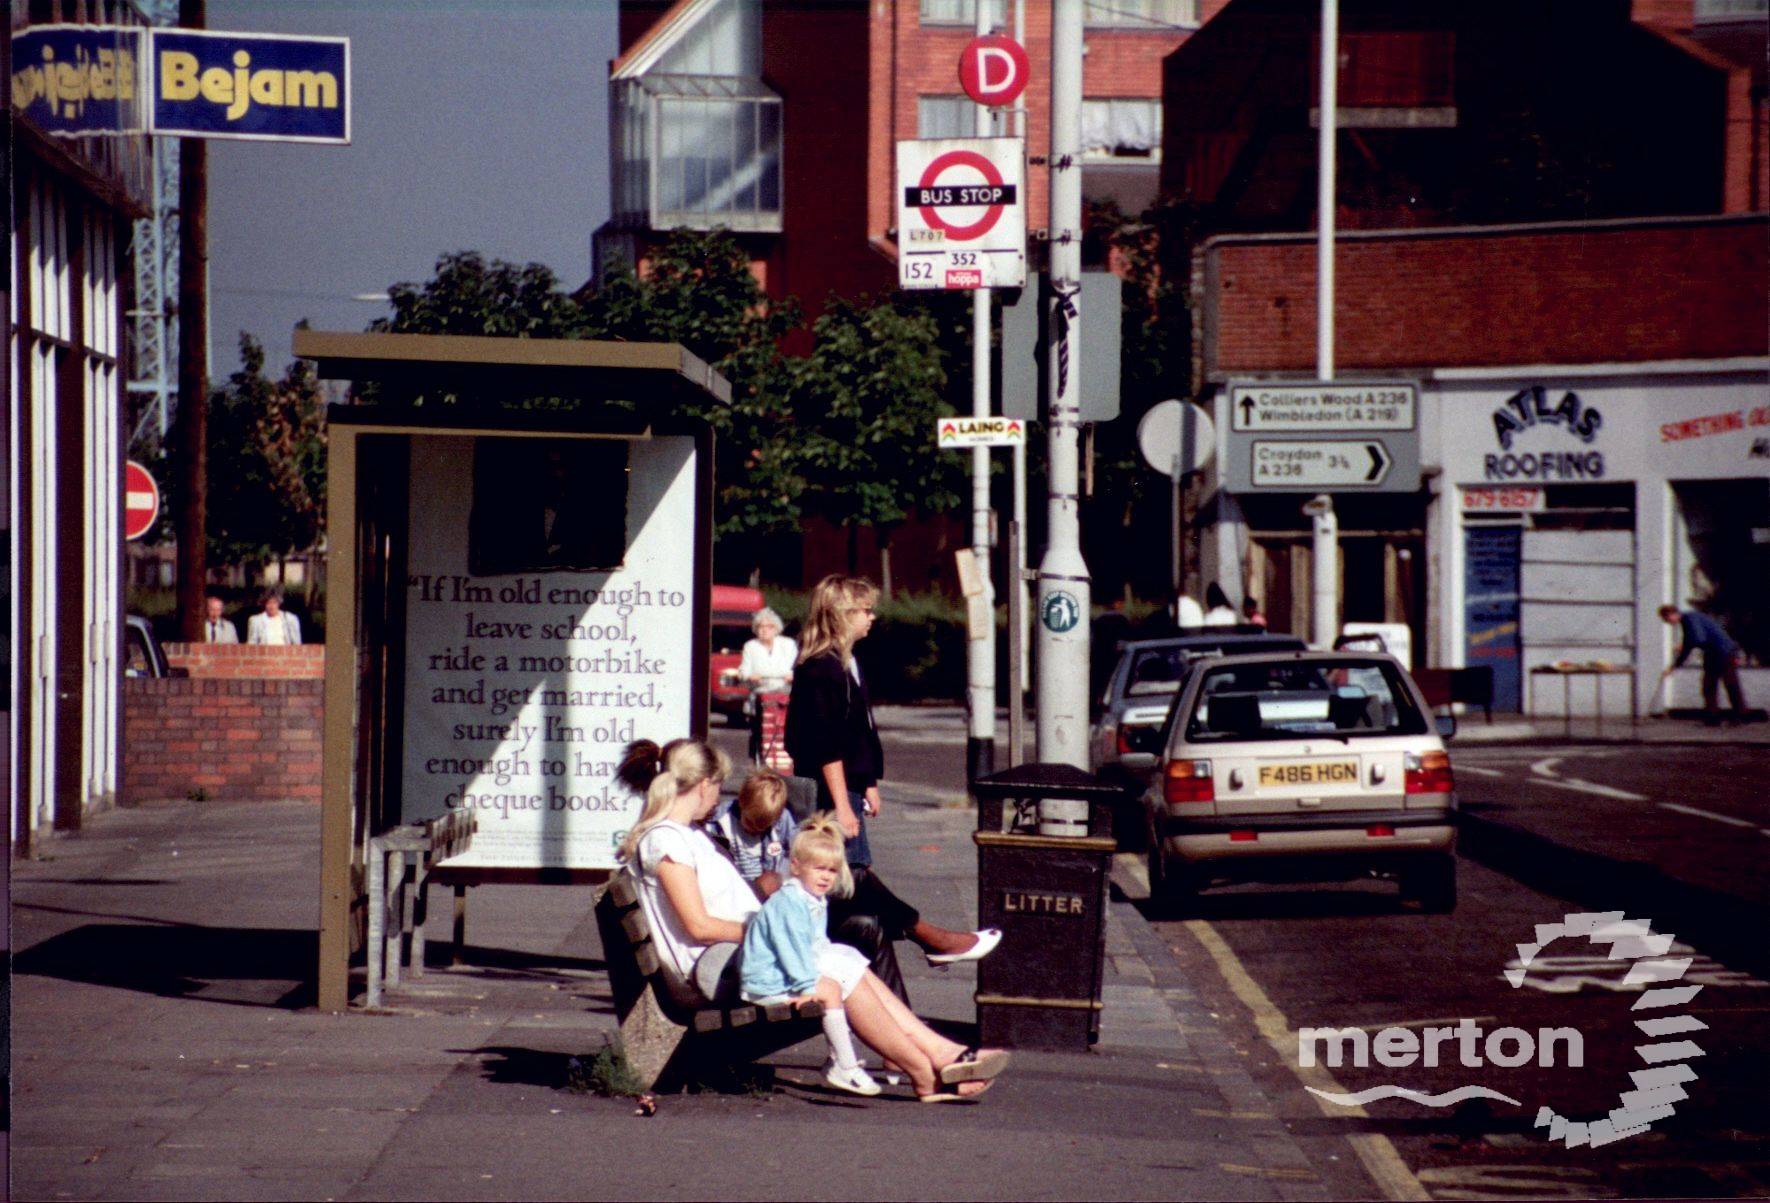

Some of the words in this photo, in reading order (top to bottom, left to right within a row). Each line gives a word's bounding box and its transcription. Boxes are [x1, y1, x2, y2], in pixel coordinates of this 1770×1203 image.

[976, 47, 1016, 94] D
[161, 50, 338, 121] Bejam
[920, 189, 952, 204] BUS
[960, 187, 1003, 203] STOP
[905, 262, 933, 280] 152
[951, 253, 977, 266] 352
[947, 273, 980, 286] hoppa
[1259, 393, 1317, 406] Colliers
[1320, 392, 1361, 405] Wood
[1365, 392, 1375, 405] A
[959, 421, 1004, 434] LAING
[1259, 410, 1341, 422] Wimbledon
[1493, 386, 1602, 450] ATLAS
[1259, 448, 1322, 462] Croydon
[1484, 451, 1605, 480] ROOFING
[499, 578, 542, 605] old
[547, 581, 651, 617] enough
[656, 586, 686, 608] to
[465, 612, 533, 640] leave
[540, 614, 637, 644] school,
[428, 646, 485, 672] ride
[494, 655, 510, 672] a
[517, 649, 666, 675] motorbike
[431, 679, 485, 705] and
[490, 688, 533, 715] get
[540, 682, 664, 713] married,
[453, 715, 537, 751] surely
[592, 717, 636, 744] old
[424, 750, 531, 786] enough
[538, 757, 567, 776] to
[1260, 765, 1313, 784] F486
[1317, 763, 1358, 781] HGN
[444, 786, 544, 820] cheque
[1004, 893, 1084, 914] LITTER
